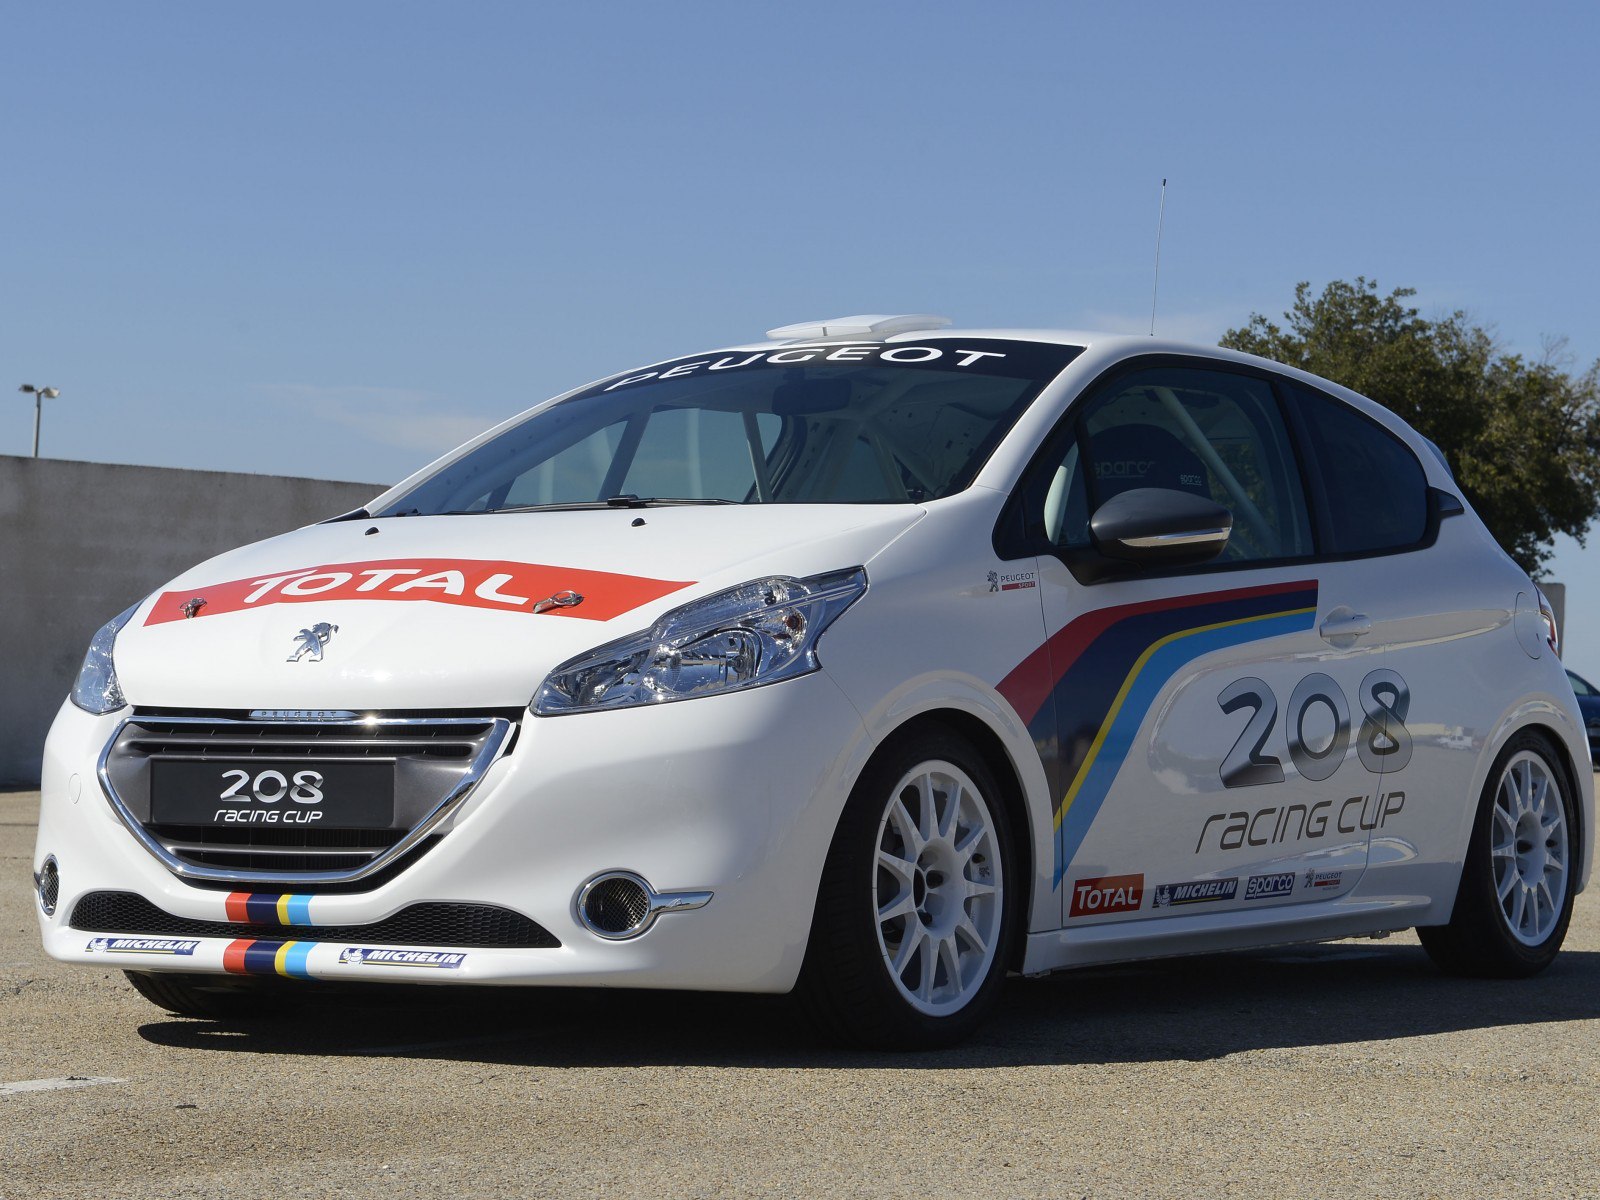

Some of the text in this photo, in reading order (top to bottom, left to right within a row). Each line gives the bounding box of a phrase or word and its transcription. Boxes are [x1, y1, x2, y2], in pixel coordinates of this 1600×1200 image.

[603, 346, 1006, 392] PEUGEOT
[242, 568, 533, 605] TOTAL
[1000, 572, 1035, 582] PEUGEOT
[261, 710, 337, 718] PEUGEOT
[1216, 668, 1413, 789] 208
[219, 769, 324, 804] 208
[282, 810, 323, 823] CUP
[1337, 791, 1406, 834] CUP
[1315, 871, 1343, 880] PEUGEOT
[1076, 885, 1139, 910] TOTAL
[1173, 878, 1236, 899] MICHELIN
[111, 939, 198, 952] MICHELIN
[366, 949, 464, 964] MICHELIN
